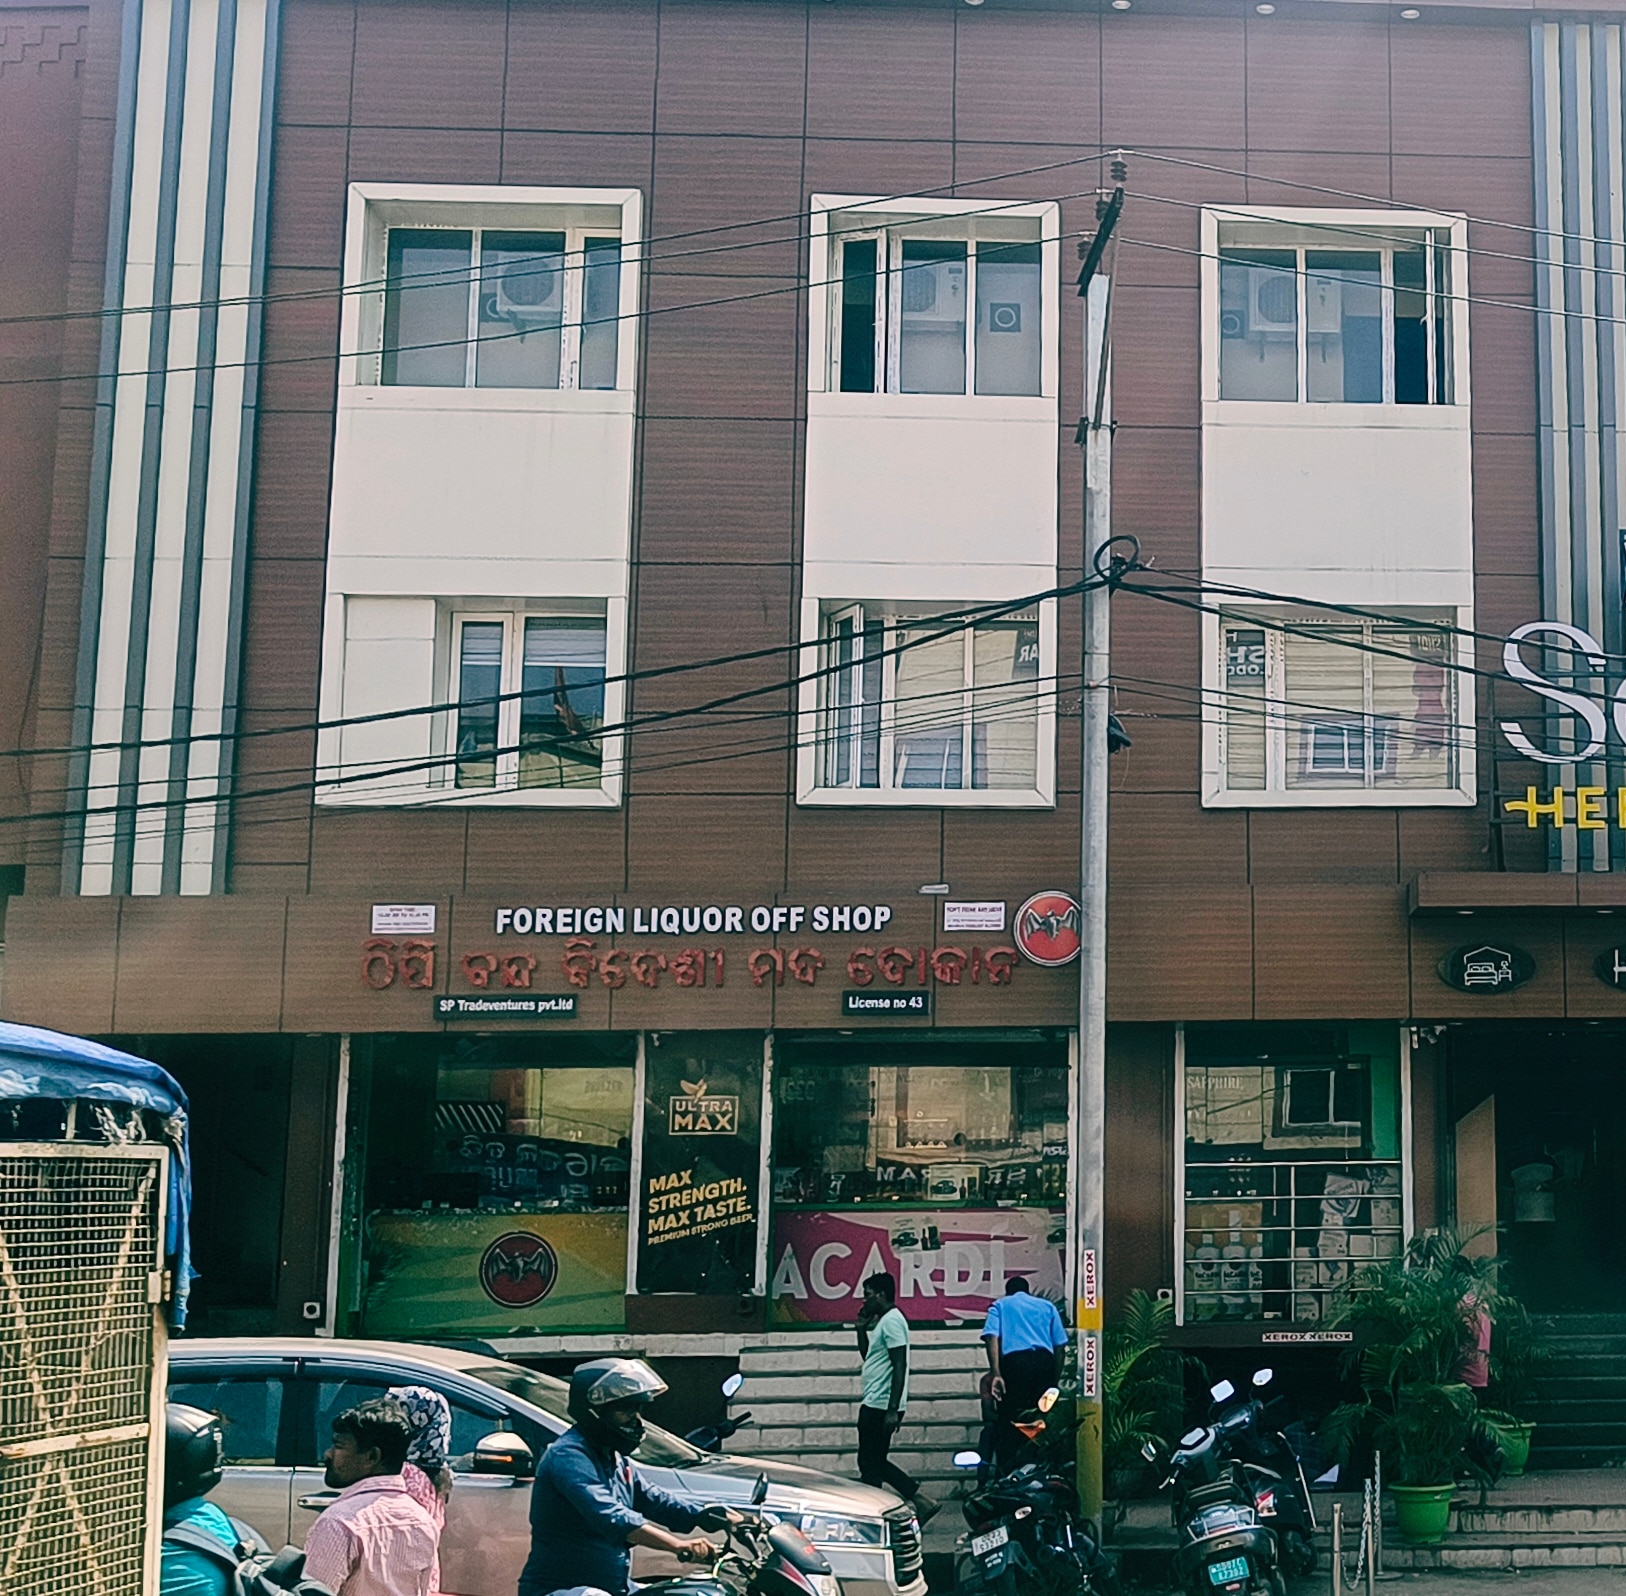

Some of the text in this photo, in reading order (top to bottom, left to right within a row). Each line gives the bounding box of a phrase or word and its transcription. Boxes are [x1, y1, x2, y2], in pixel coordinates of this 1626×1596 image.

[496, 905, 891, 935] FOREIGN LIQUOR OFF SHOP
[440, 999, 455, 1011] SP
[457, 999, 535, 1011] Tradeventures
[848, 996, 923, 1009] License no 43
[675, 1101, 732, 1112] ULTRA
[674, 1113, 732, 1131] MAX
[650, 1169, 692, 1194] MAX
[649, 1177, 747, 1214] STRENGTH.
[648, 1195, 751, 1234] MAX TASTE.
[648, 1213, 753, 1246] PREMIUM STRONG BEER
[1086, 1252, 1095, 1306] XEROX
[1264, 1332, 1351, 1341] XEROX XEROX
[1086, 1340, 1094, 1394] XEROX
